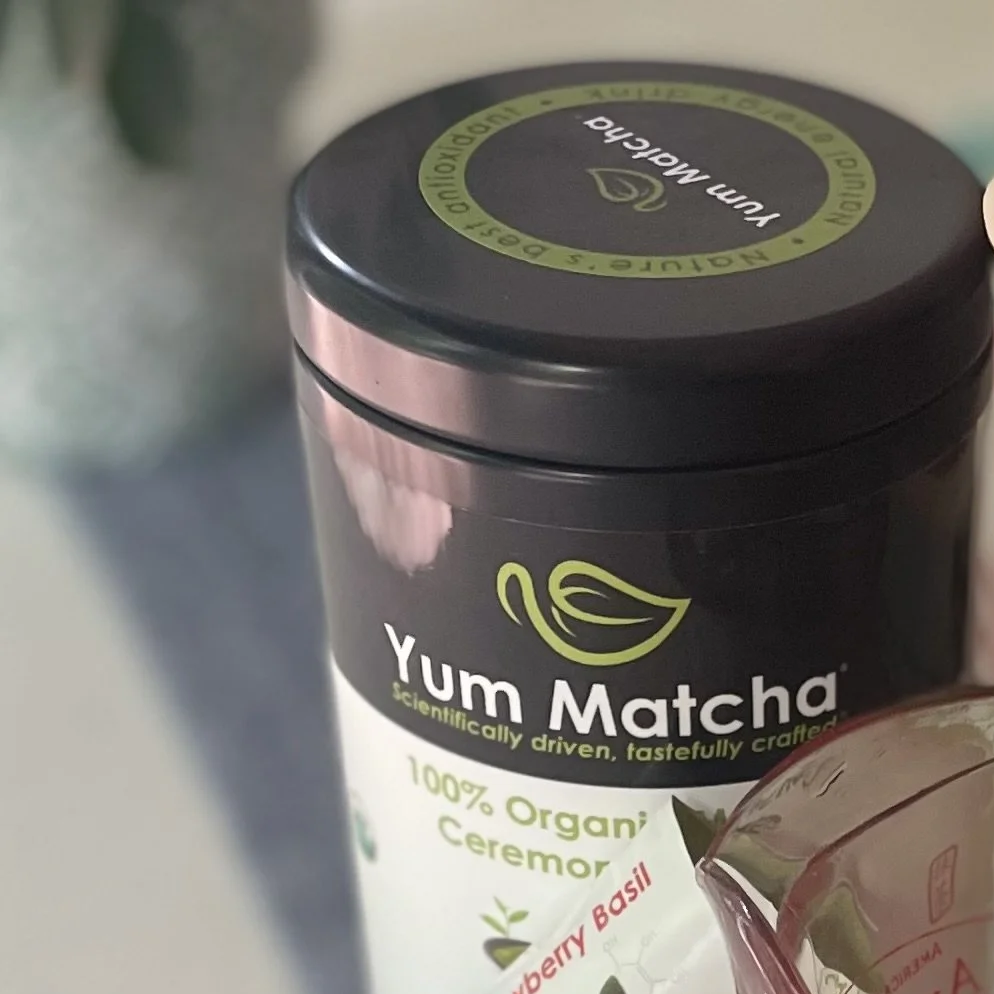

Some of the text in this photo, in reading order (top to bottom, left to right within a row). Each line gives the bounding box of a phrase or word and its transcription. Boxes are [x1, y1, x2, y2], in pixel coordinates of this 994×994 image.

[426, 107, 770, 272] Nature's best antioxidant
[583, 116, 780, 227] Yum Matcha
[384, 623, 836, 738] Yum Matcha
[392, 681, 838, 761] Scientifically driven, tastefully crafted
[408, 755, 647, 842] 100% Organi
[592, 862, 652, 932] Basil
